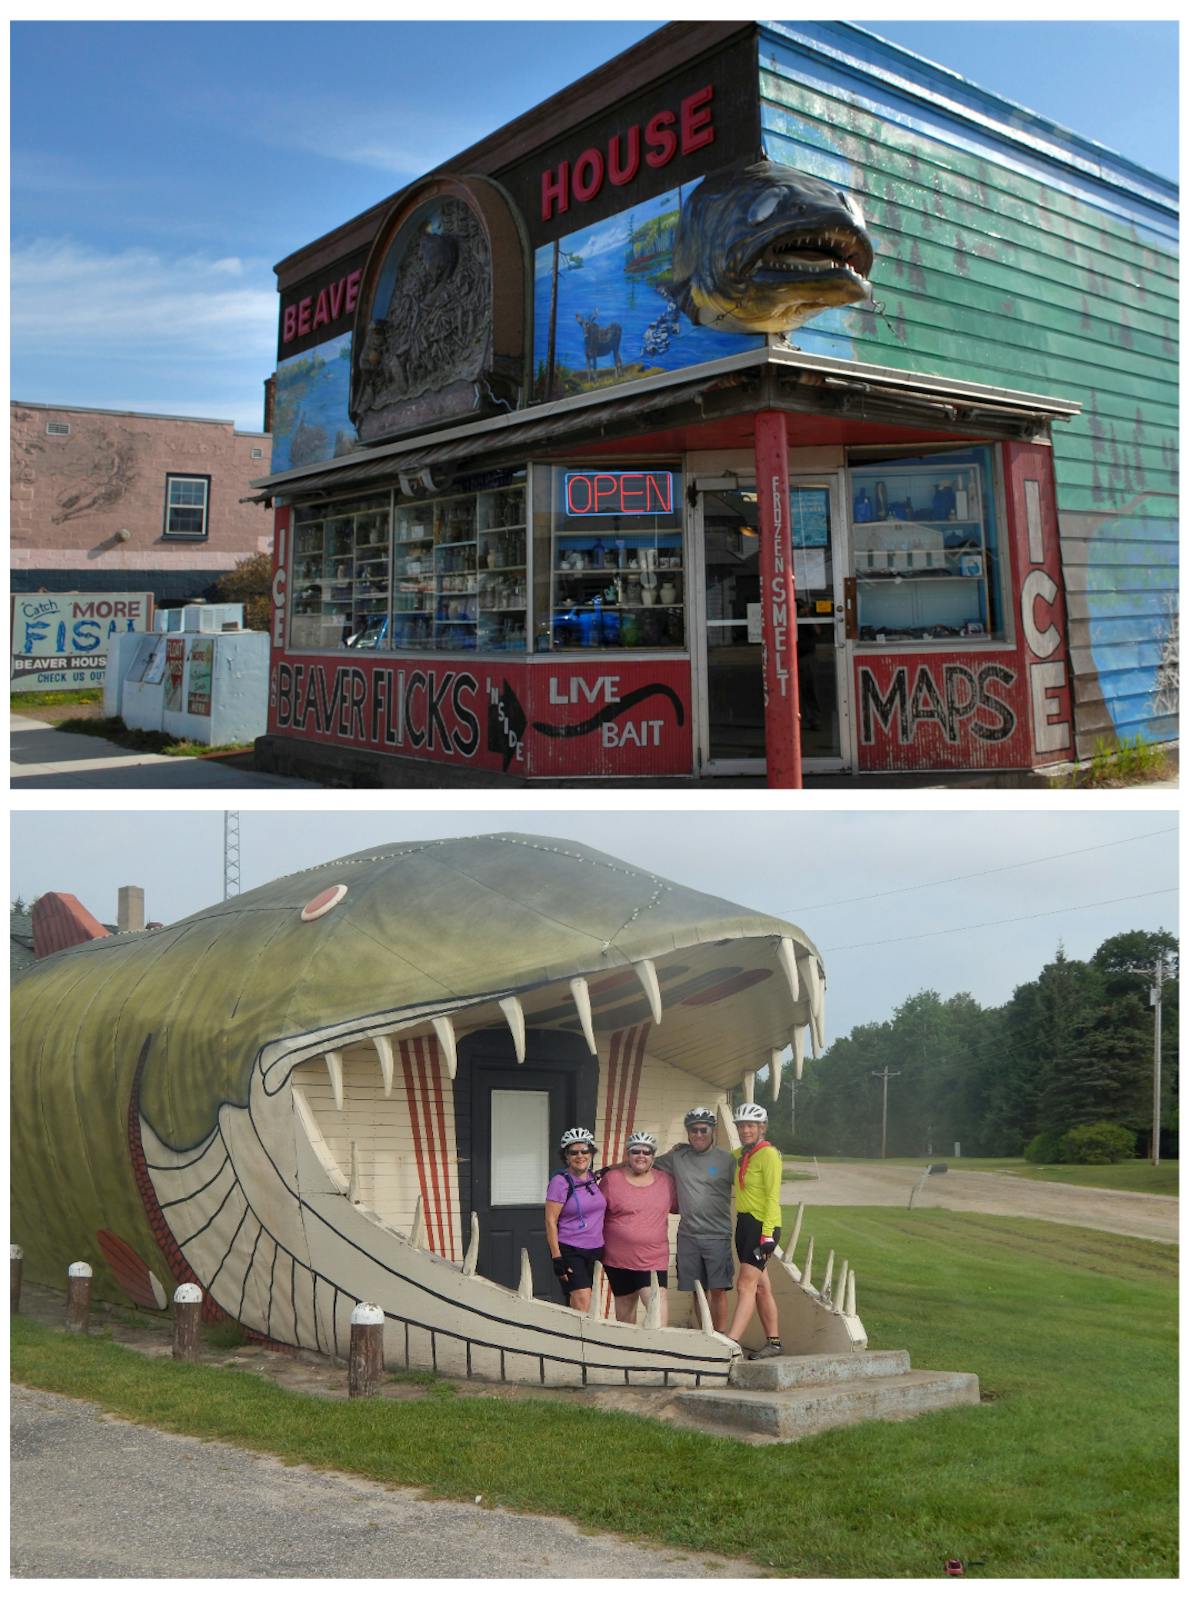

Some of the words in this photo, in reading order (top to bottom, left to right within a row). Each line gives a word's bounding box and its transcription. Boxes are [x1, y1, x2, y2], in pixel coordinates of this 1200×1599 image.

[540, 85, 715, 222] HOUSE
[283, 268, 361, 344] BEAVE
[567, 473, 672, 514] OPEN
[772, 476, 784, 573] FROZEN
[23, 600, 60, 618] Catch
[72, 601, 141, 618] MORE
[272, 528, 287, 648] ICE
[1021, 479, 1070, 754] ICE
[15, 659, 67, 670] BEAVER
[71, 657, 106, 667] HOUS
[771, 578, 789, 697] SMELT
[37, 672, 66, 683] CHECK
[73, 672, 85, 681] US
[277, 662, 368, 740] BEAVER
[371, 669, 480, 758] FLICKS
[549, 676, 620, 703] LIVE
[858, 664, 1018, 746] MAPS
[602, 720, 664, 748] BAIT
